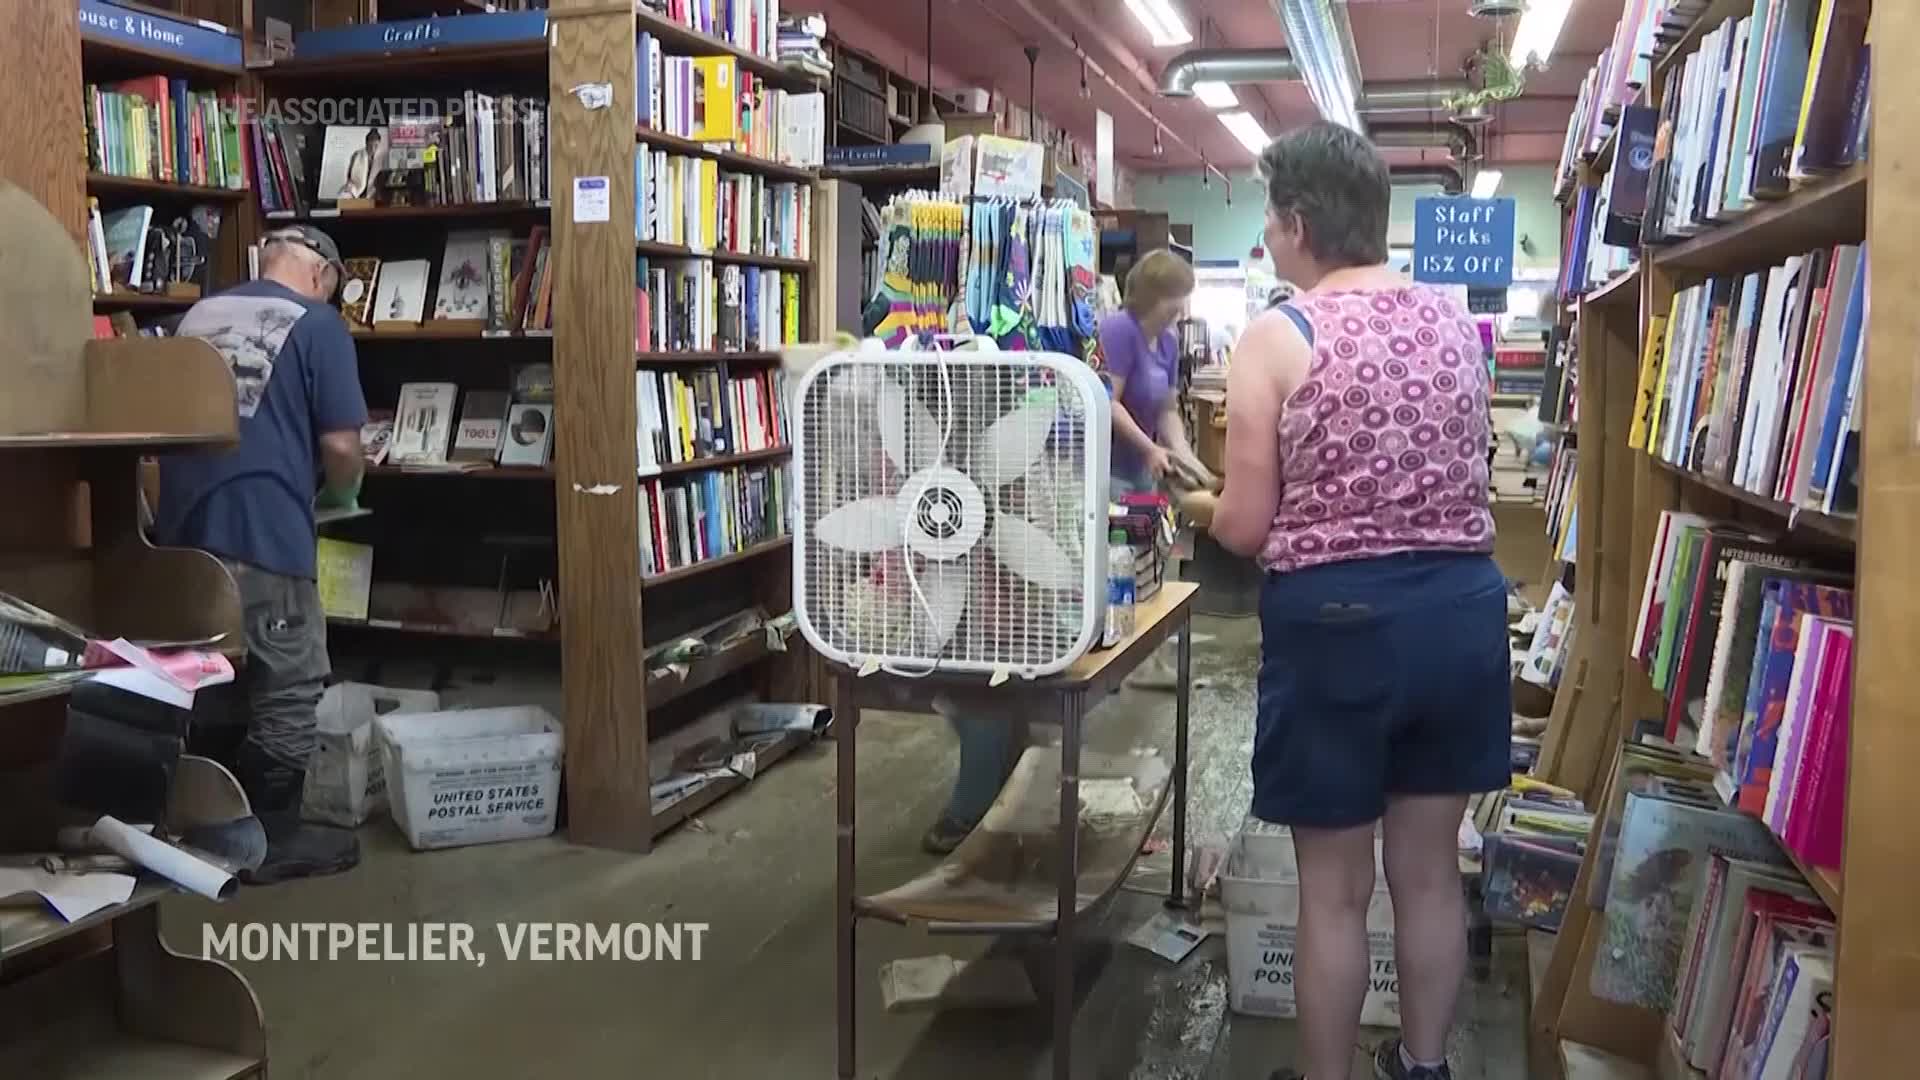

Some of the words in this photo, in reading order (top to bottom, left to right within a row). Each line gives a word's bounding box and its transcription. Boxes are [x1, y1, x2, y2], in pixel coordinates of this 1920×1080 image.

[79, 8, 119, 30] ouse
[140, 19, 185, 46] Home
[384, 23, 441, 42] Crafts
[1435, 205, 1495, 223] Staff
[1437, 226, 1491, 245] Picks
[1423, 255, 1456, 273] 15%
[1464, 255, 1504, 273] Off
[464, 427, 497, 440] TOOLS
[1719, 547, 1794, 569] AUTOBIOGRAPH
[433, 790, 484, 806] UNITED
[488, 784, 539, 800] STATES
[428, 806, 481, 820] POSTAL
[487, 798, 545, 815] SERVICE
